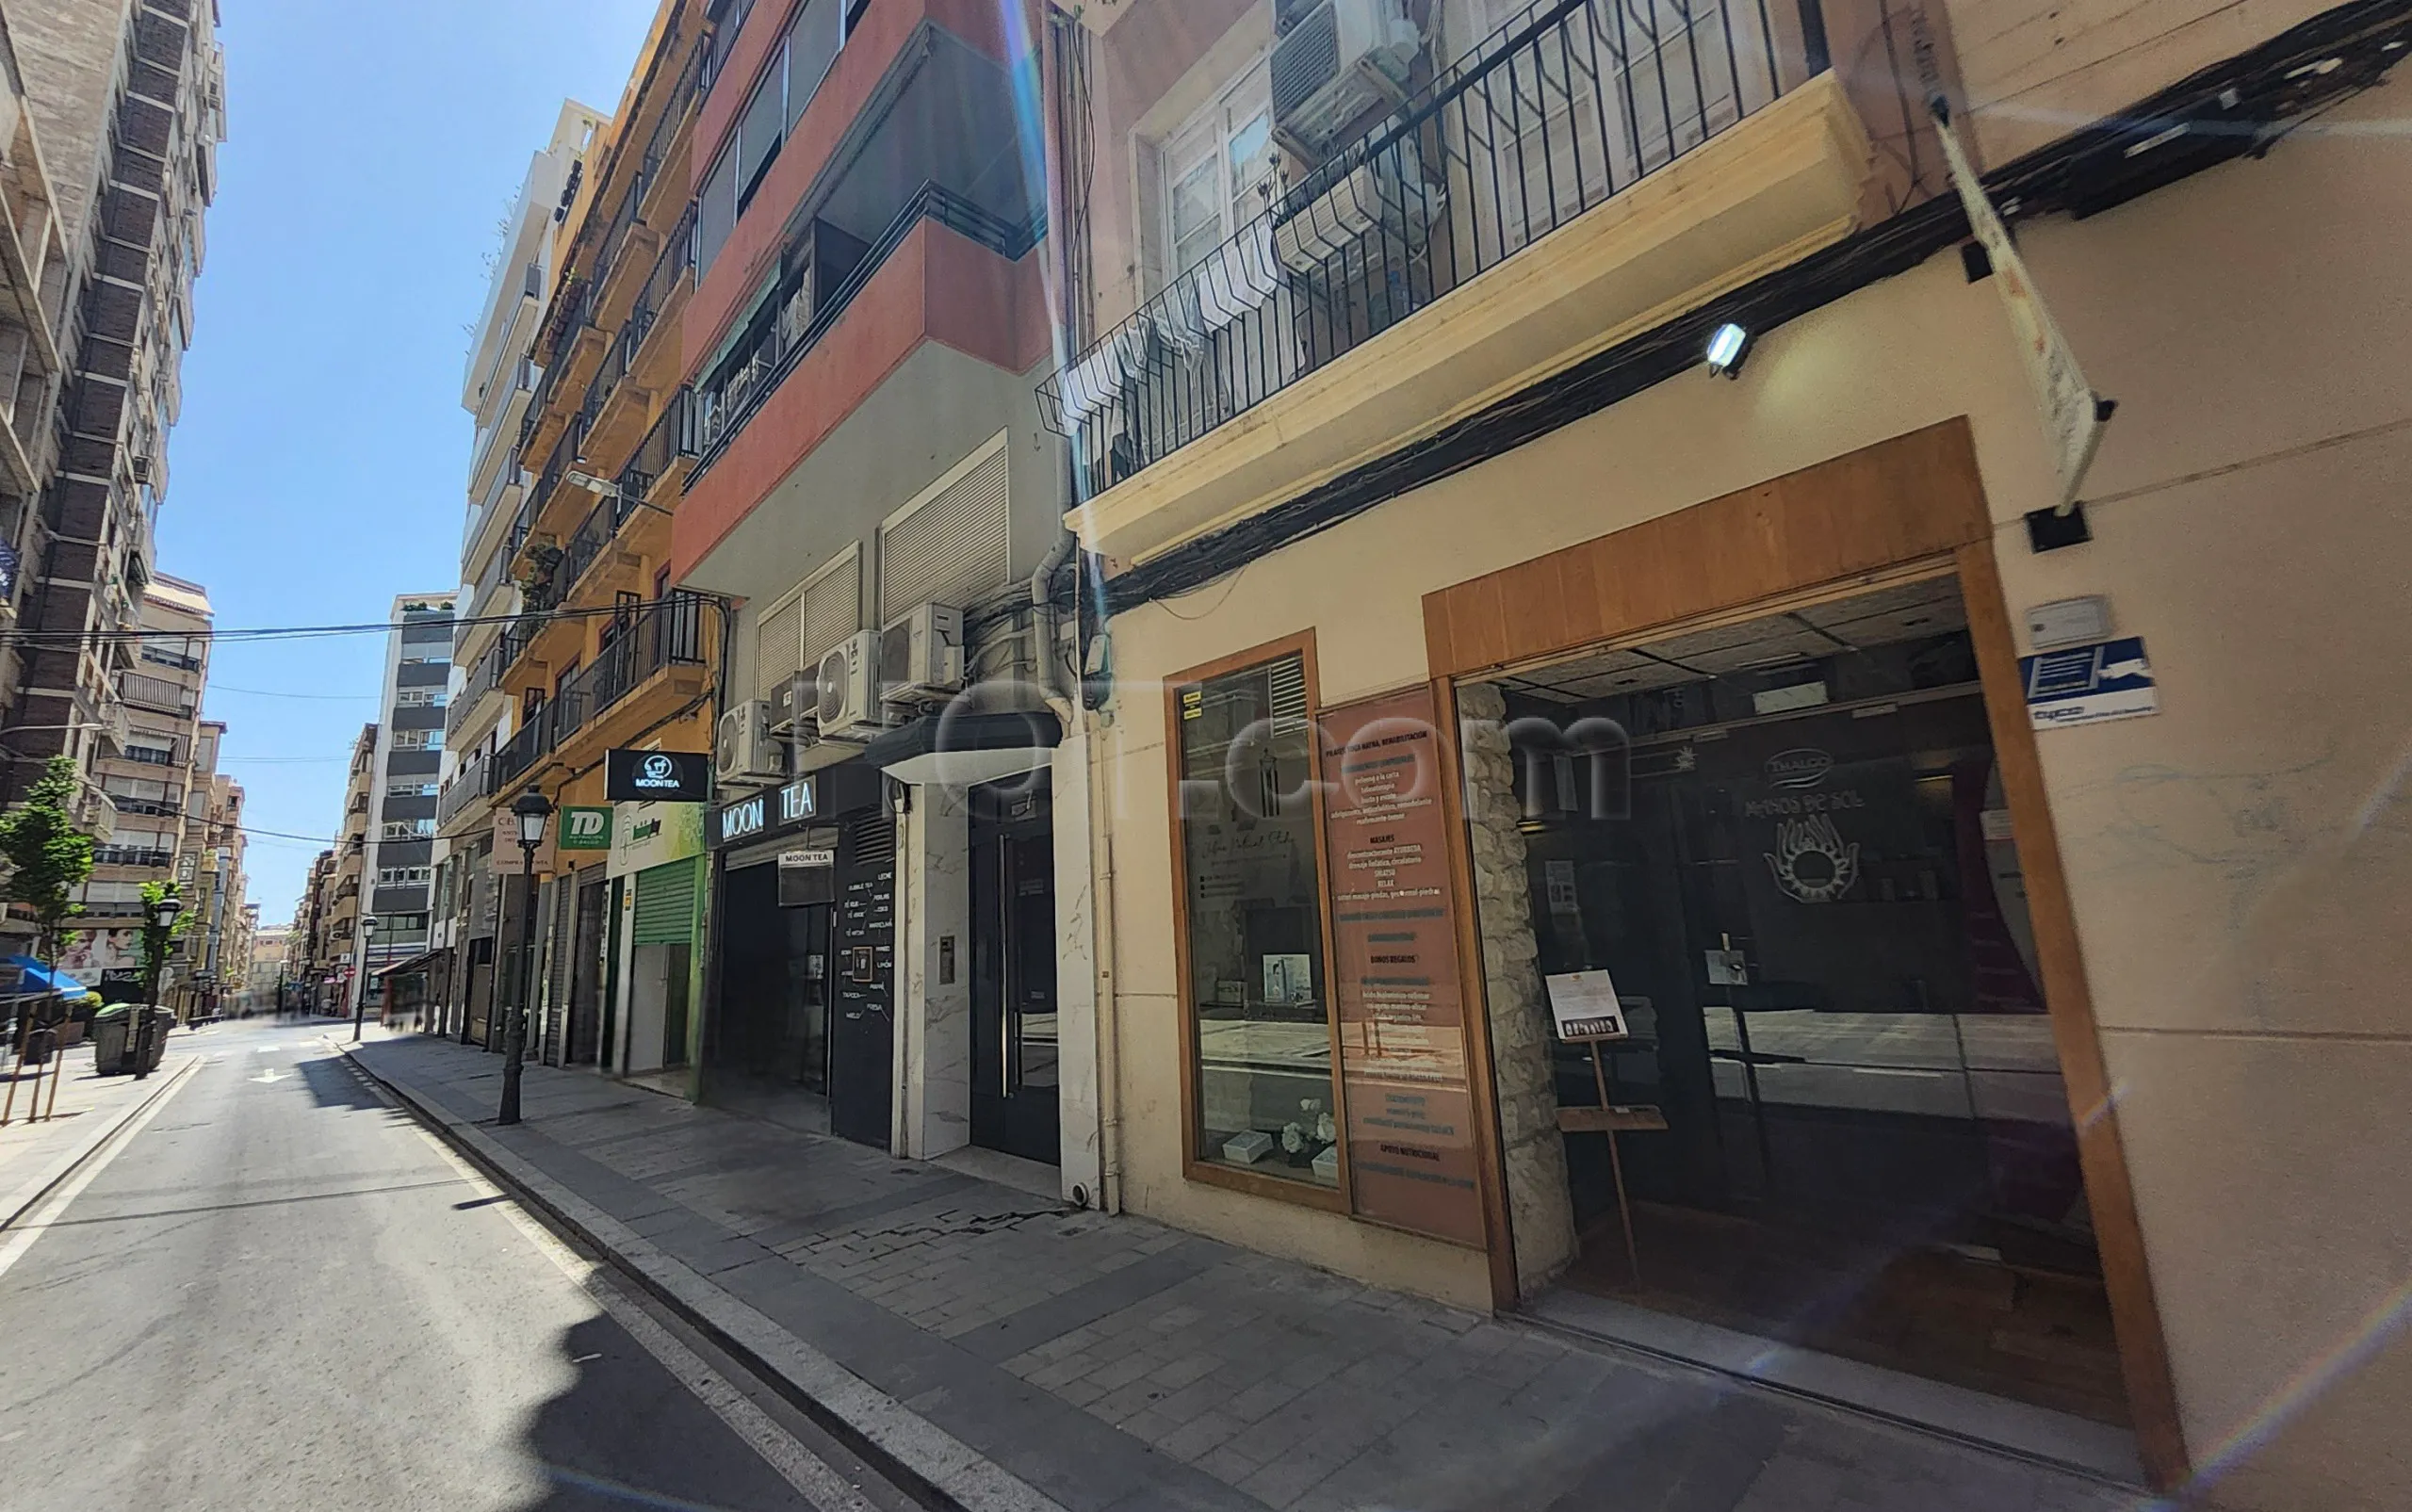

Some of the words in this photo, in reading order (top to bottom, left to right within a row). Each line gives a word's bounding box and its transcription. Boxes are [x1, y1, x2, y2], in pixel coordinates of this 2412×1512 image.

[570, 811, 604, 835] TD
[722, 798, 764, 839] MOON
[780, 782, 813, 820] TEA
